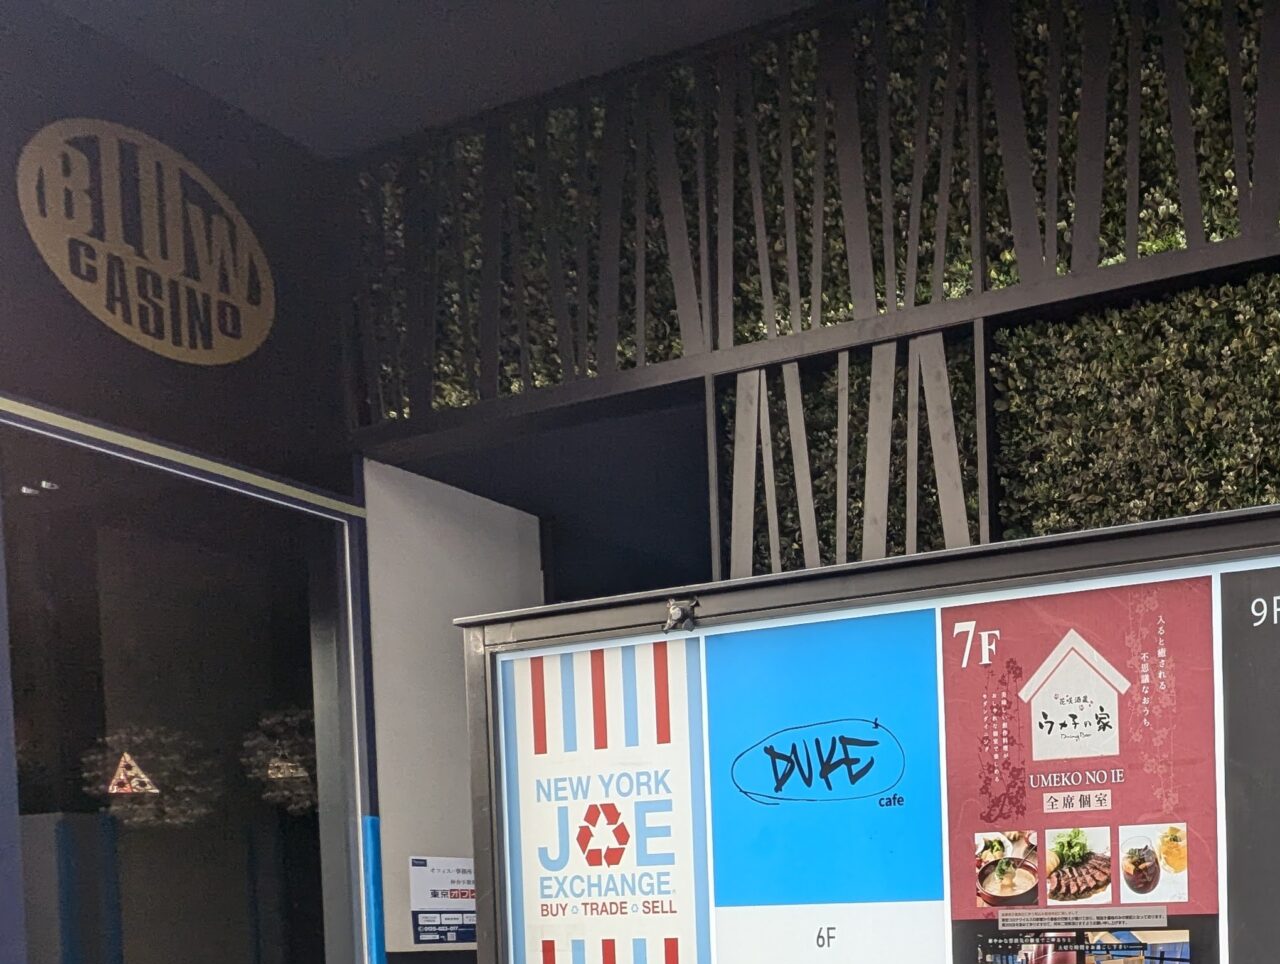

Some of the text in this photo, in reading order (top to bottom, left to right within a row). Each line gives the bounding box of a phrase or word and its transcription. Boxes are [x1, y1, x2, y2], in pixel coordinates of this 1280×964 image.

[40, 134, 258, 300] BLOW
[67, 236, 242, 350] CASINO
[953, 620, 1000, 669] 7F
[763, 735, 879, 793] DUKE
[1030, 768, 1125, 788] UMEKO NO IE
[535, 769, 672, 803] NEW YORK
[878, 793, 904, 807] cafe
[1046, 792, 1109, 811] 全席個室
[539, 871, 672, 899] EXCHANGE
[540, 900, 677, 917] BUY TRADE SELL
[816, 927, 836, 948] 6F
